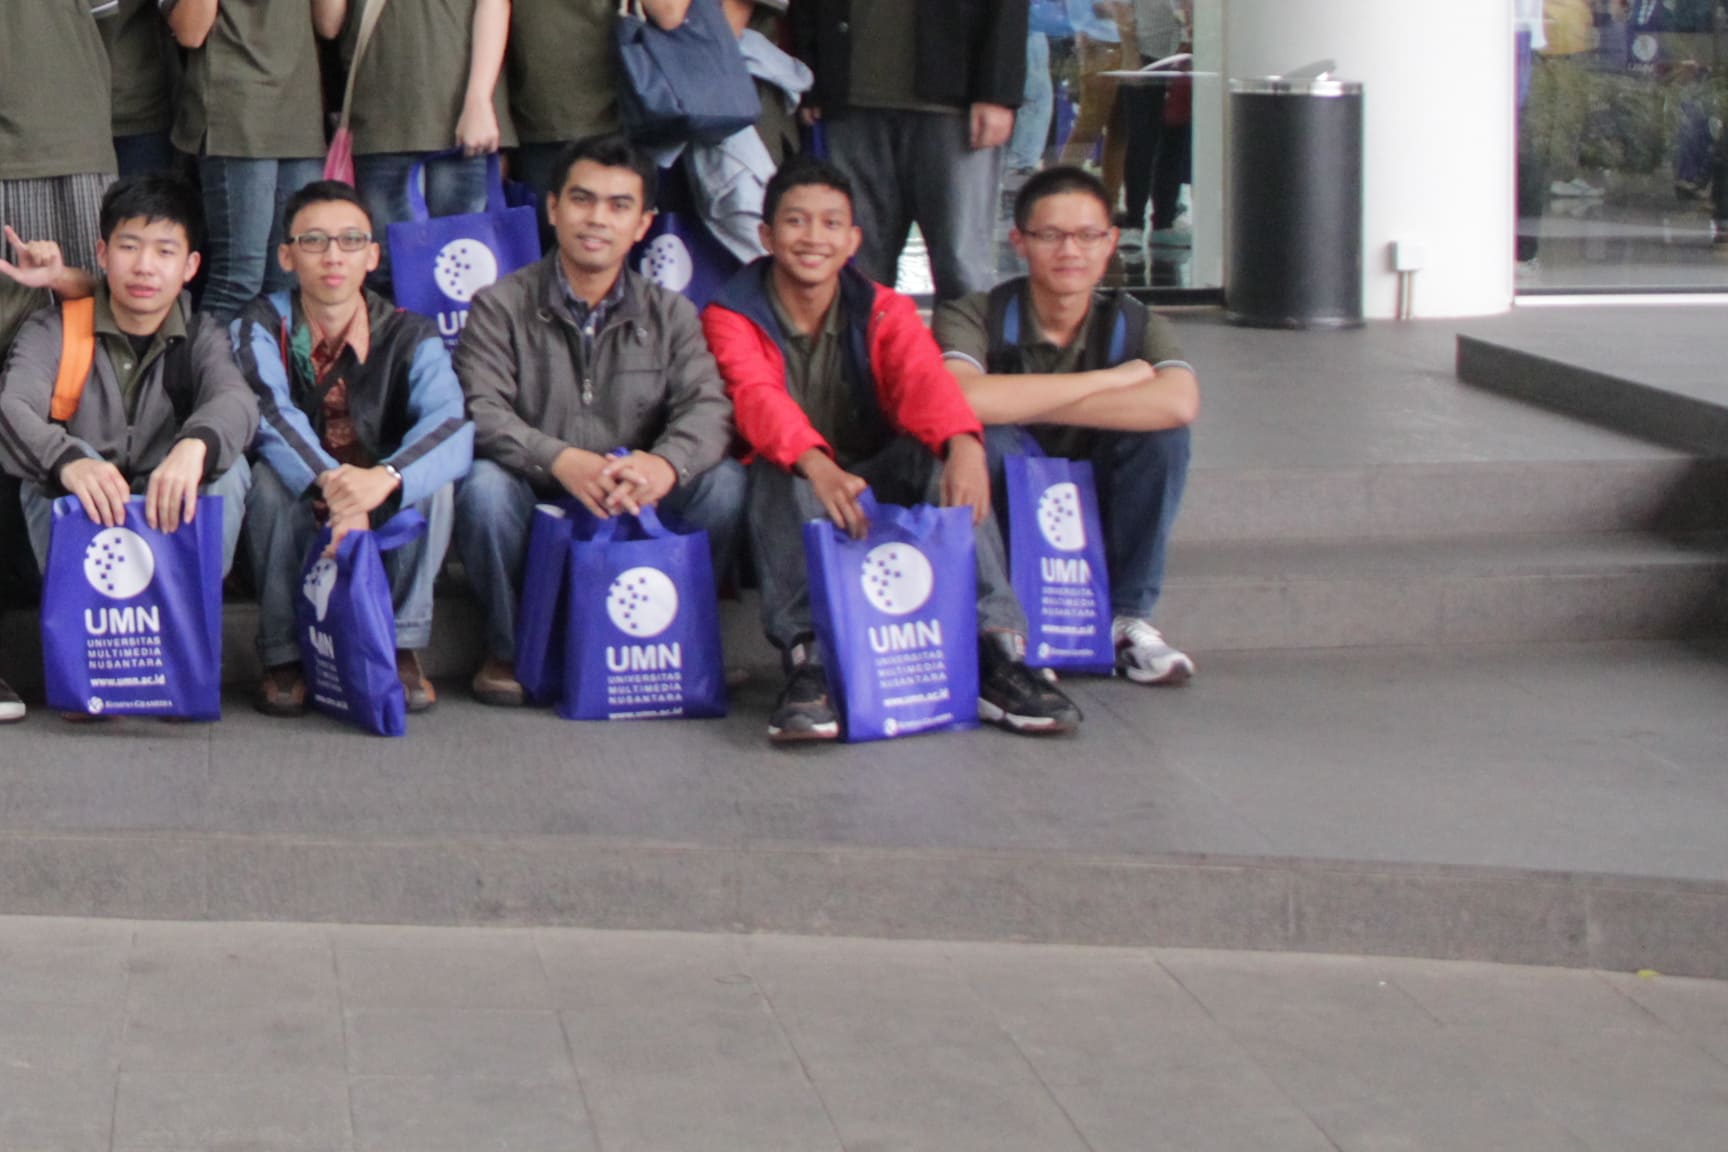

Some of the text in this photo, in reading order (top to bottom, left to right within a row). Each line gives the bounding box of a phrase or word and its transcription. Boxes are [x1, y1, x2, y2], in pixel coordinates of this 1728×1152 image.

[84, 605, 160, 635] UMN
[868, 618, 943, 653] UMN
[86, 636, 161, 648] UNIVERSITAS
[87, 647, 162, 659] MULTIMEDIA
[605, 641, 681, 672] UMN
[88, 658, 163, 669] NUSANTARA
[607, 672, 682, 684] UNIVERSITAS
[608, 682, 682, 695] MULTIMEDIA
[608, 693, 683, 705] NUSANTARA
